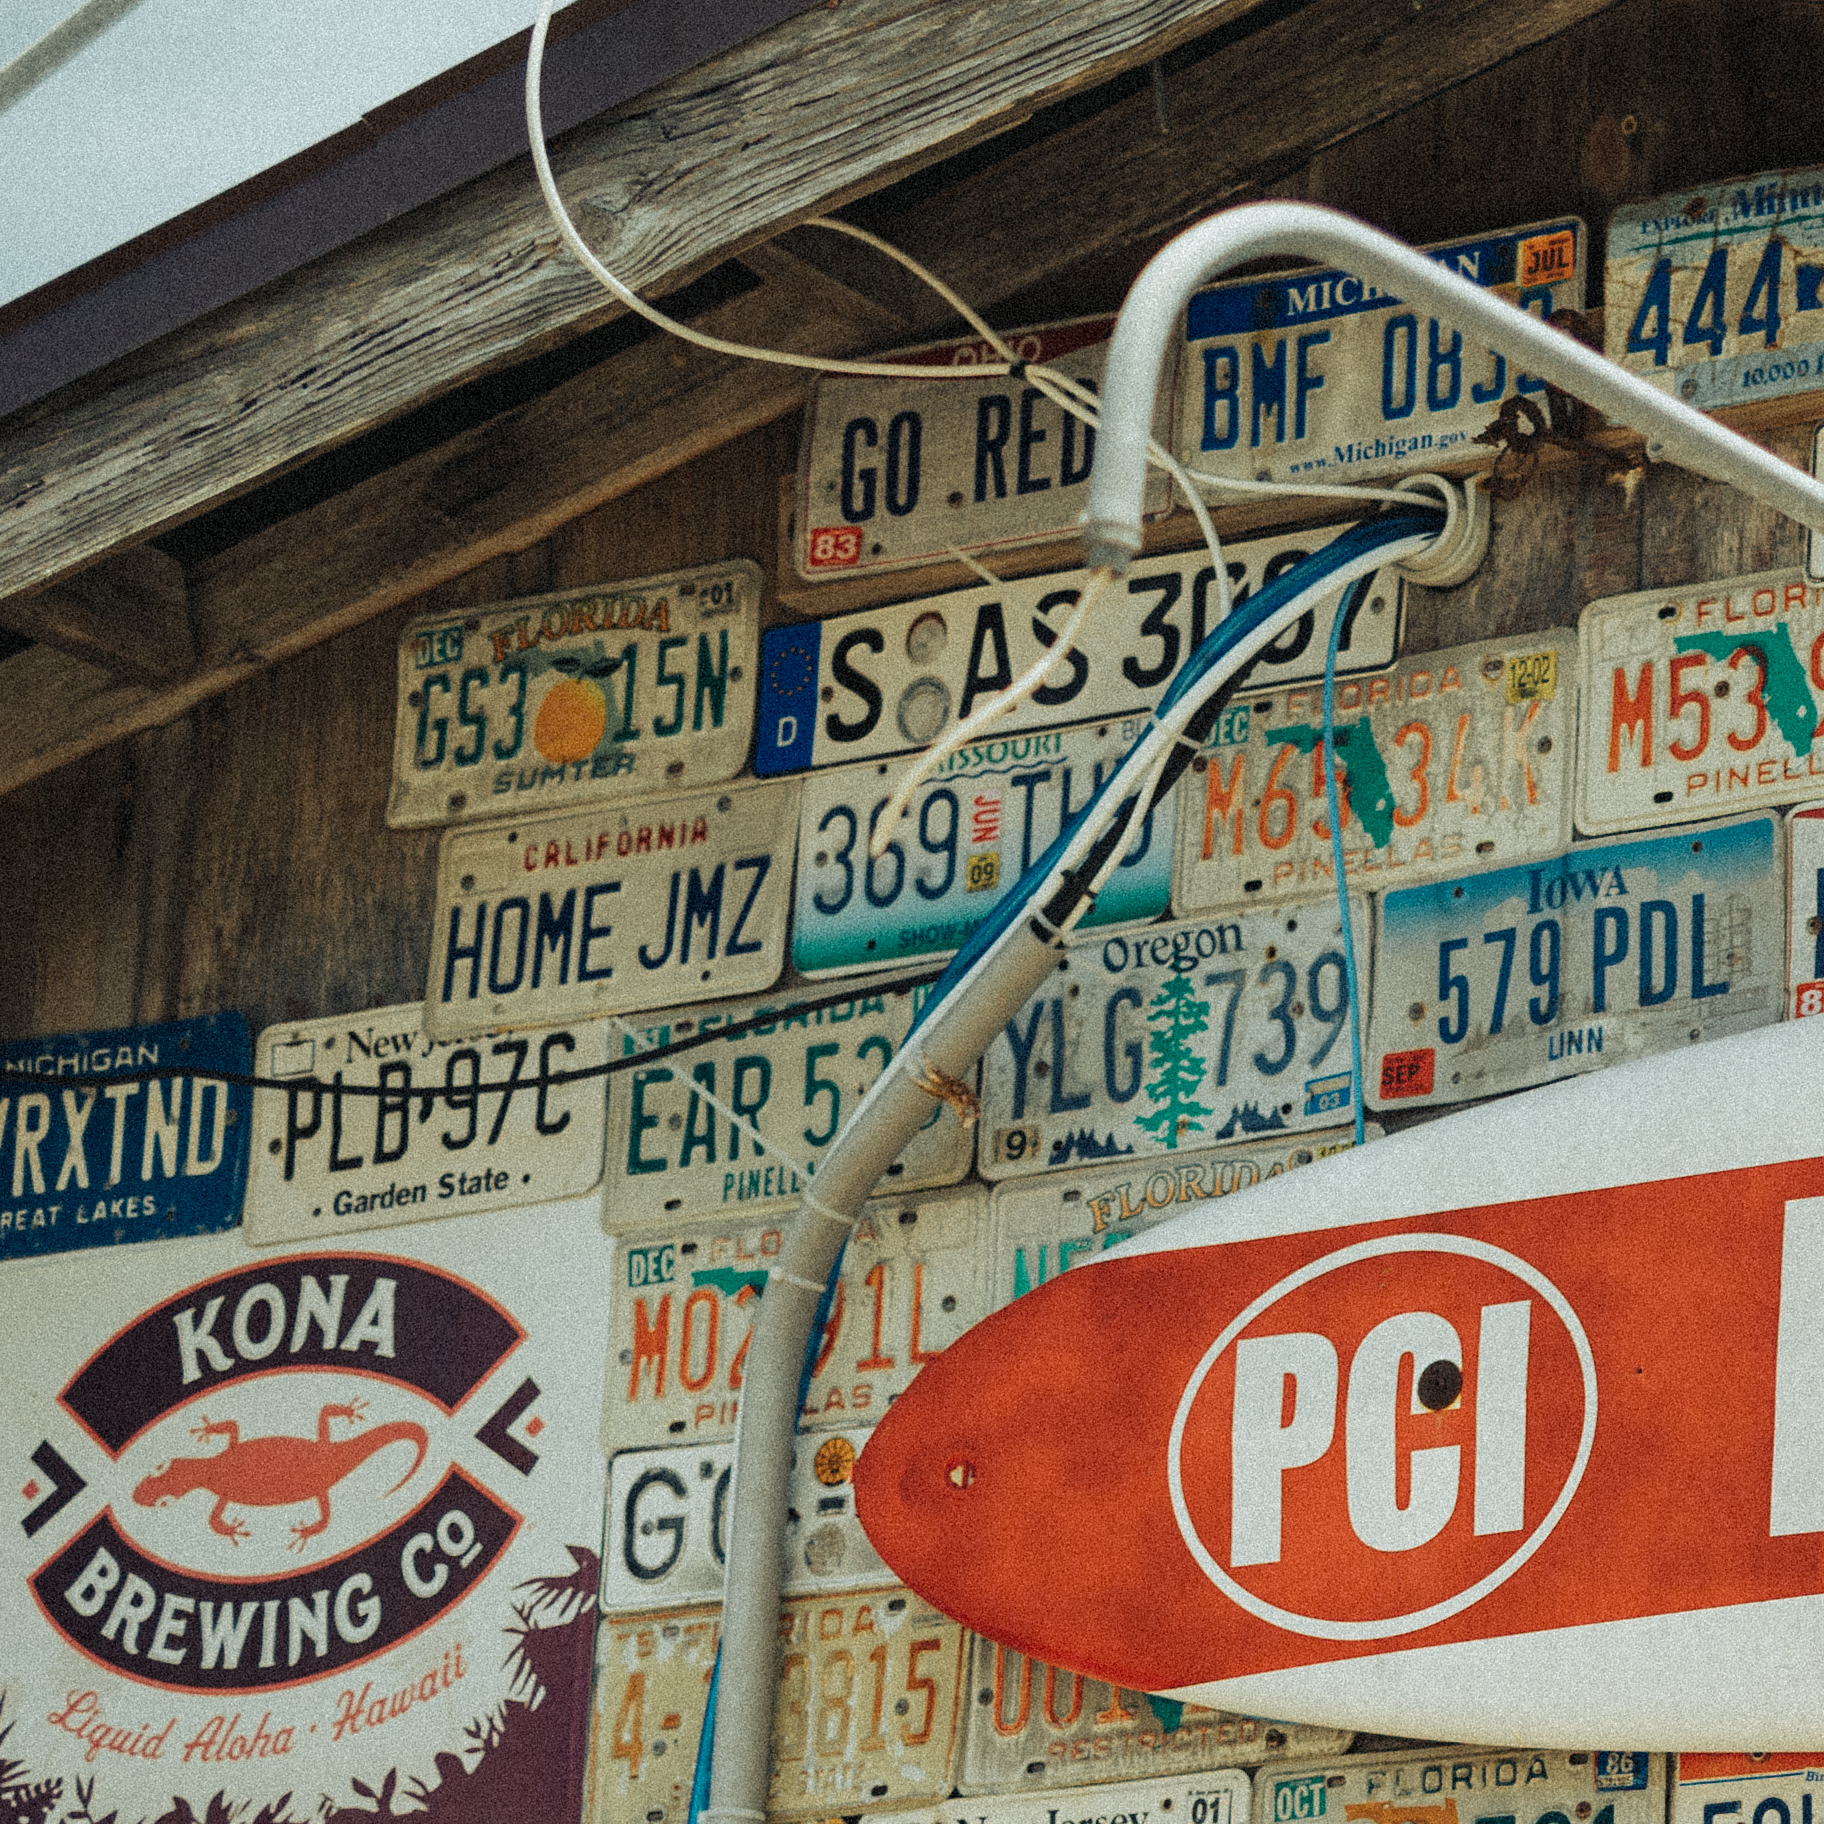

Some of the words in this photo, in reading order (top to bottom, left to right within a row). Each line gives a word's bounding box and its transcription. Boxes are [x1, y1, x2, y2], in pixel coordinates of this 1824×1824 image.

[1525, 239, 1569, 276] JUL
[1627, 234, 1785, 367] 444
[1200, 330, 1332, 454] BMF
[840, 409, 922, 524] GO
[414, 628, 462, 669] DEC
[416, 663, 525, 770] GS3
[615, 628, 727, 743] 15N
[777, 717, 797, 746] D
[493, 754, 635, 795] SUMTER
[522, 815, 709, 872] CALIFORNIA
[442, 880, 623, 1004] HOME
[638, 855, 772, 972] JMZ
[1101, 922, 1244, 975] Oregon
[1437, 919, 1564, 1046] 579
[1592, 892, 1731, 1013] PDL
[345, 1029, 415, 1065] New
[1550, 1026, 1604, 1061] LINN
[1381, 1062, 1421, 1088] SEP
[76, 1195, 157, 1226] LAKES
[332, 1179, 427, 1219] Garden
[436, 1169, 510, 1200] State
[631, 1249, 675, 1283] DEC
[172, 1271, 400, 1386] KONA
[1229, 1299, 1533, 1568] PCI
[62, 1546, 383, 1671] BREWING
[48, 1690, 176, 1763] Liquid
[183, 1709, 295, 1763] Aloha
[331, 1642, 467, 1743] Hawaii
[1275, 1780, 1326, 1821] OCT
